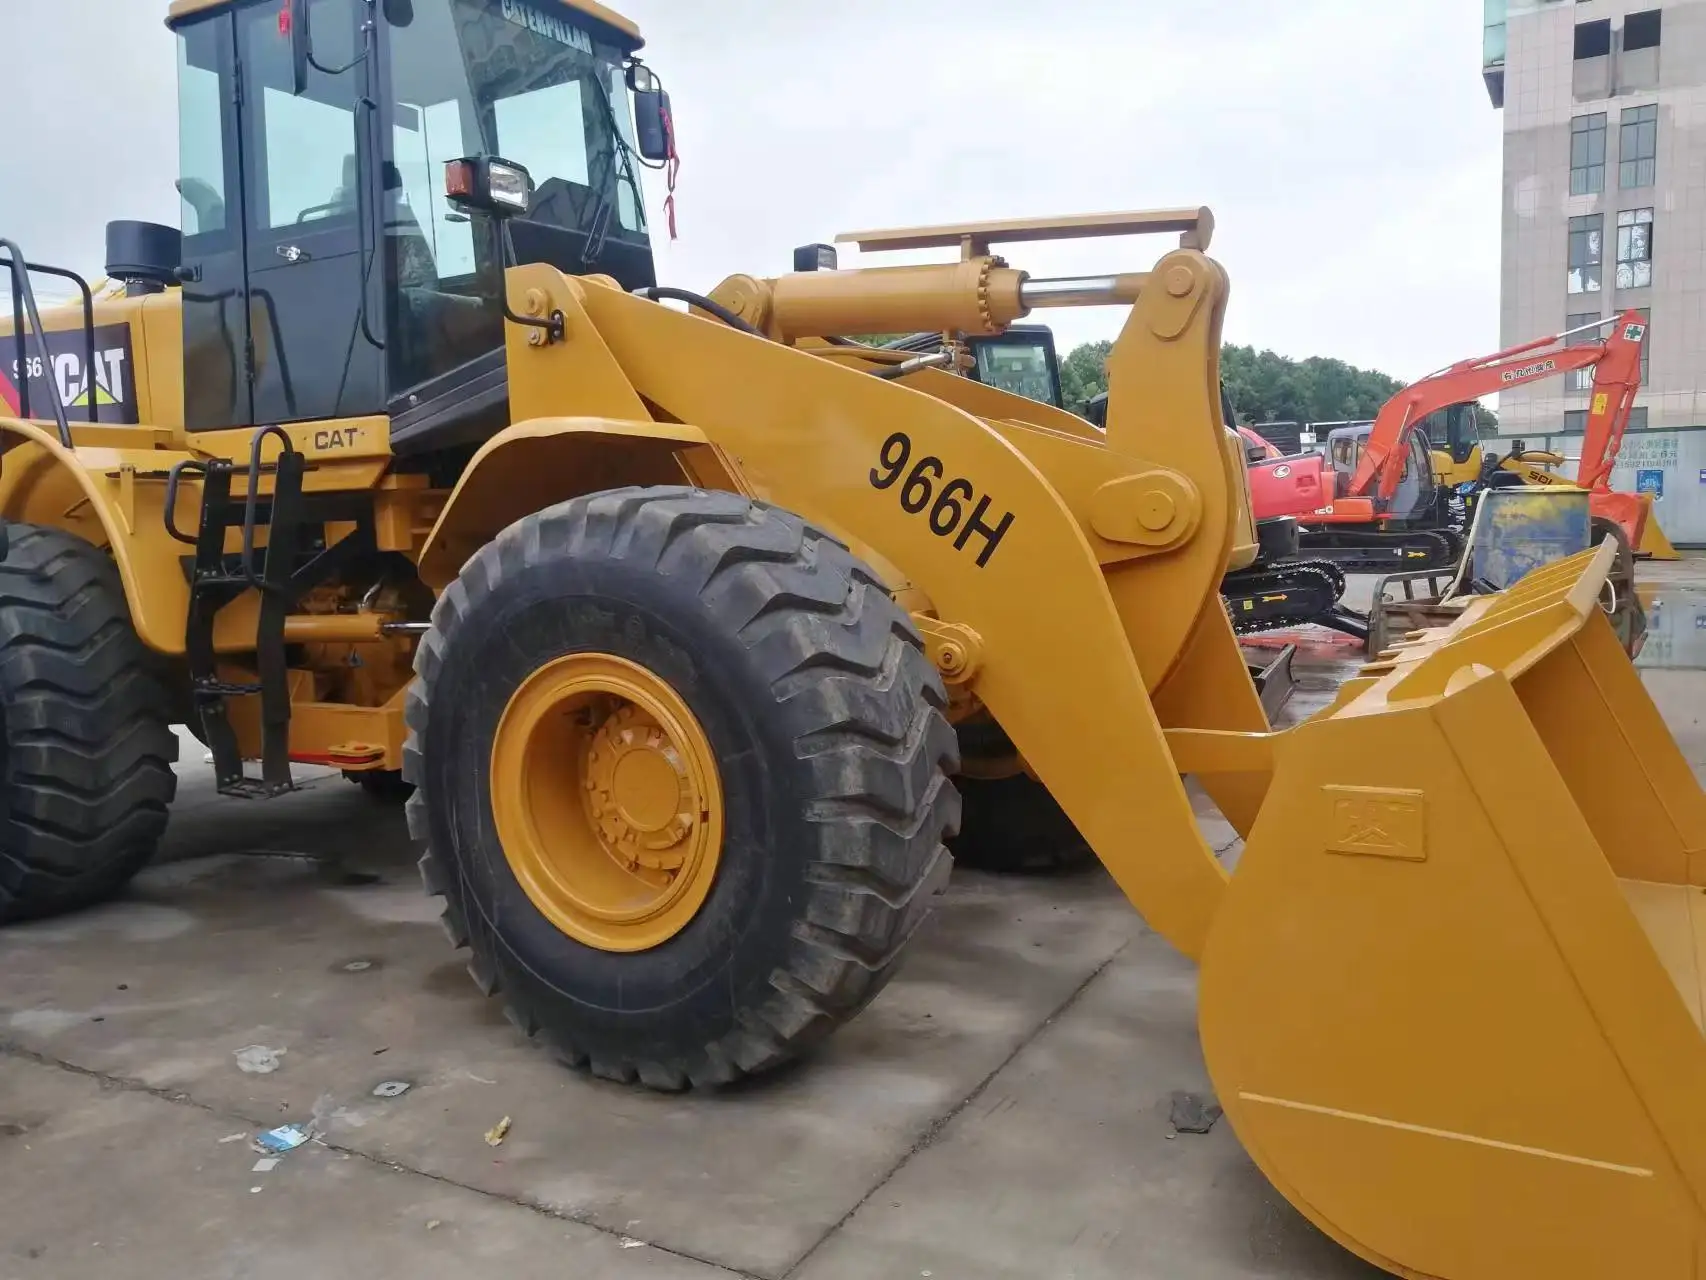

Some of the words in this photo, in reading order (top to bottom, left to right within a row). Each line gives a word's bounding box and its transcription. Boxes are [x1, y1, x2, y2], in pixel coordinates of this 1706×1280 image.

[502, 0, 592, 55] CATERPILLAR
[13, 355, 55, 380] 966
[55, 348, 125, 407] CAT
[314, 428, 358, 449] CAT
[869, 432, 1016, 569] 966H
